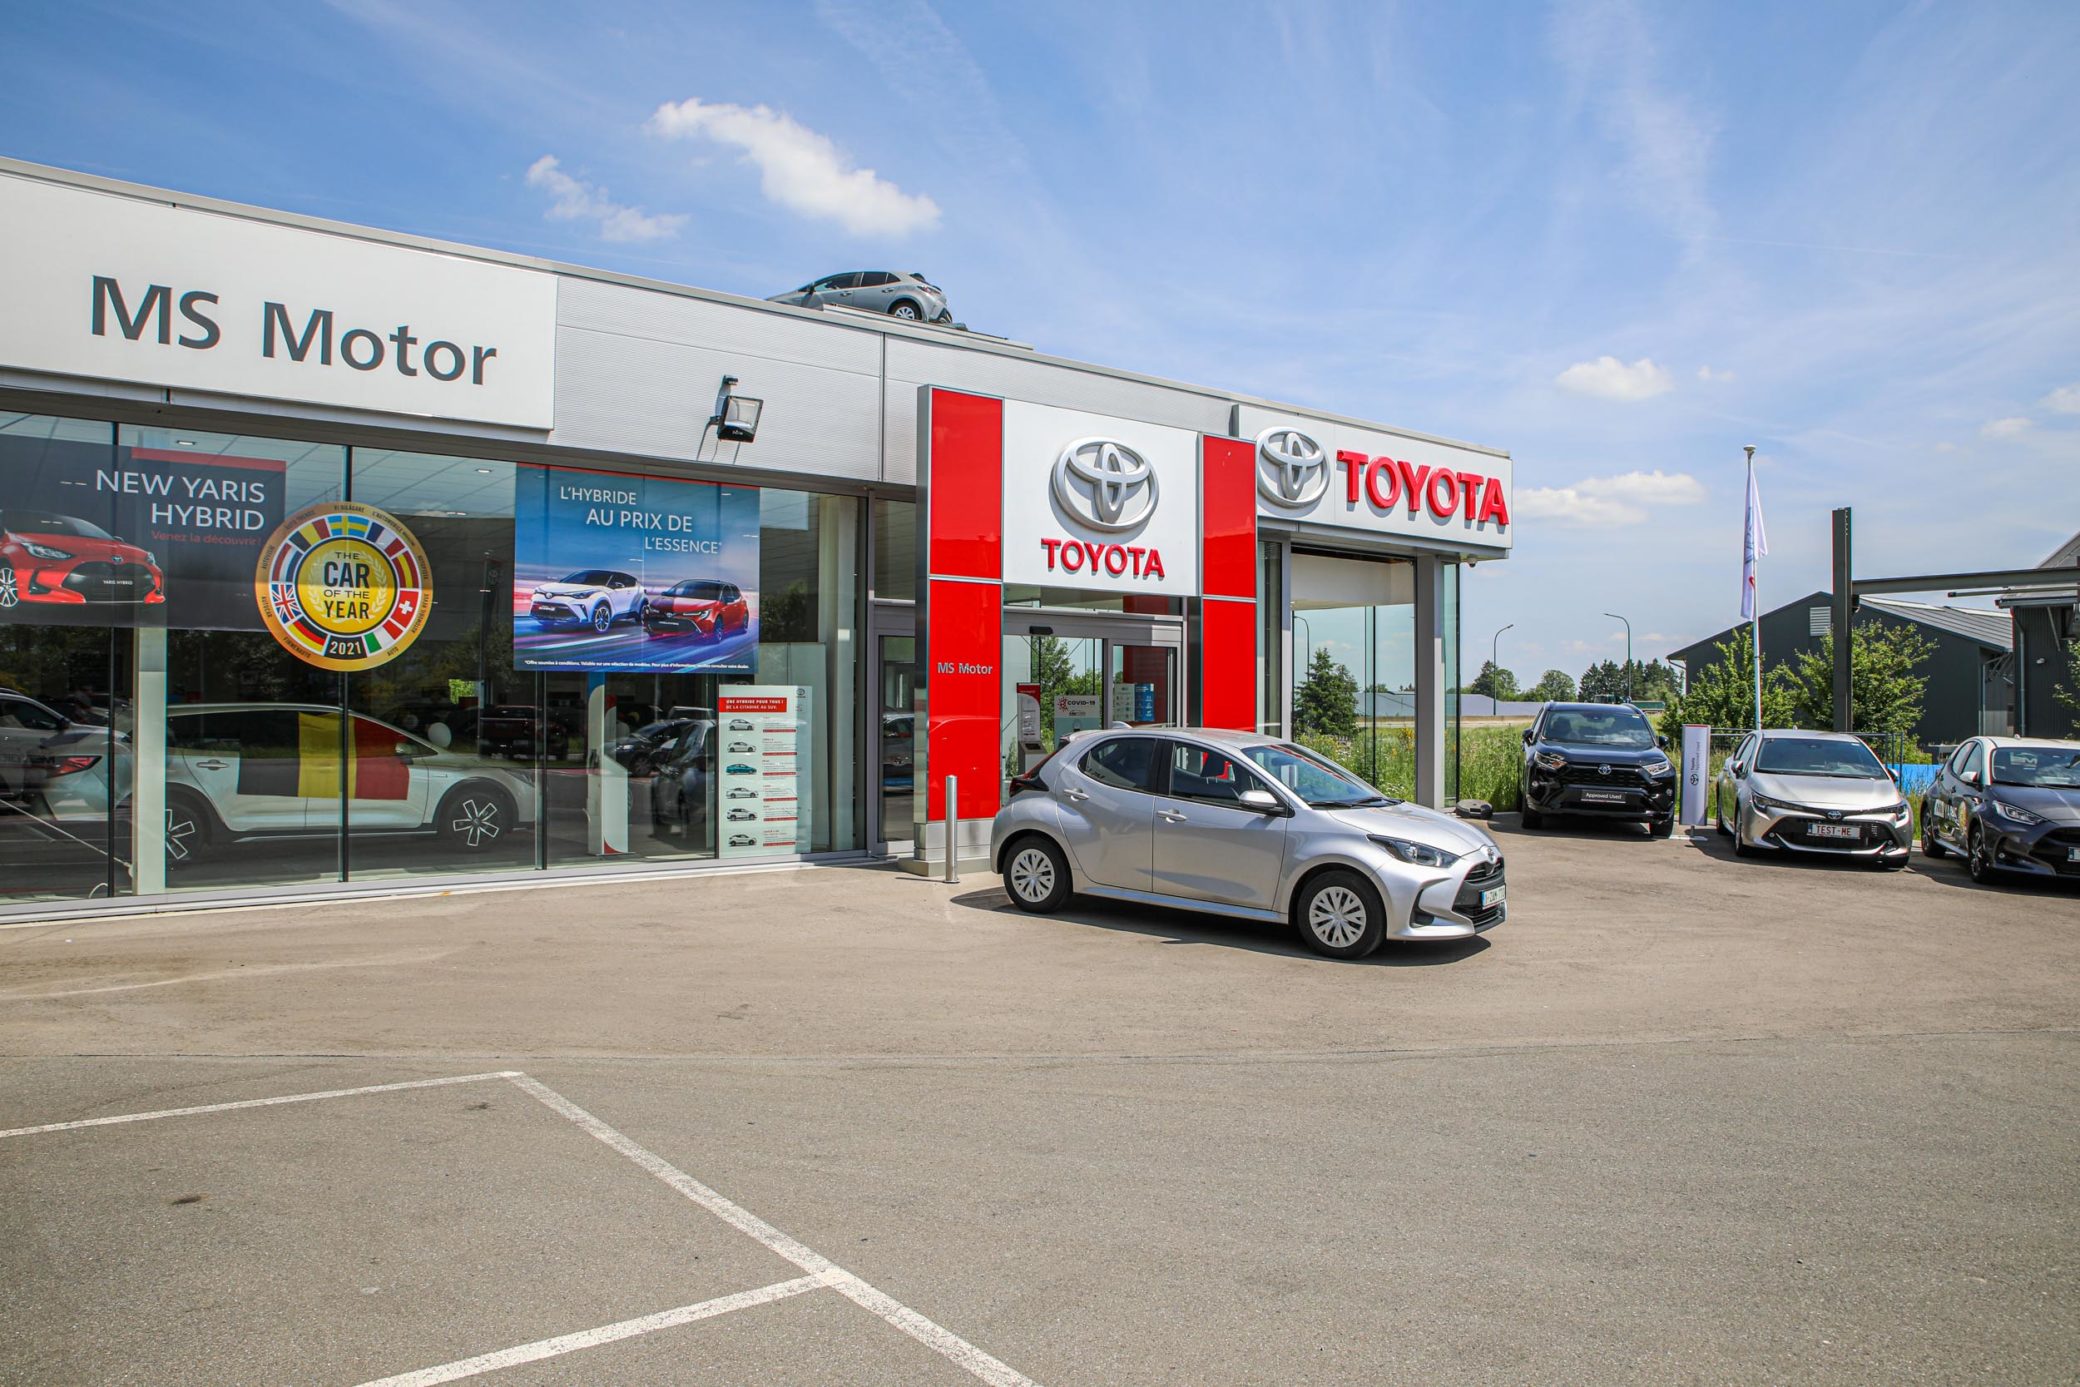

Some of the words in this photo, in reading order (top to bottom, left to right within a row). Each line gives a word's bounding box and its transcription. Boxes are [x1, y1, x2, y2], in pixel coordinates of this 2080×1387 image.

[91, 274, 221, 350] MS
[262, 301, 497, 386] Motor
[96, 469, 174, 497] NEW
[182, 476, 266, 504] YARIS
[560, 486, 637, 506] L'HYBRIDE
[1336, 449, 1510, 526] TOYOTA
[151, 503, 265, 531] HYBRID
[586, 508, 614, 527] AU
[620, 511, 662, 531] PRIX
[668, 515, 693, 533] DE
[152, 531, 187, 542] Venez
[190, 533, 201, 543] la
[335, 551, 361, 560] THE
[1041, 538, 1165, 579] TOYOTA
[324, 561, 371, 589] CAR
[323, 589, 342, 599] OF
[344, 590, 370, 600] THE
[324, 600, 370, 620] YEAR
[330, 641, 362, 656] 2021
[937, 662, 955, 674] MS
[958, 662, 993, 675] Motor
[1816, 825, 1852, 836] TEST-ME
